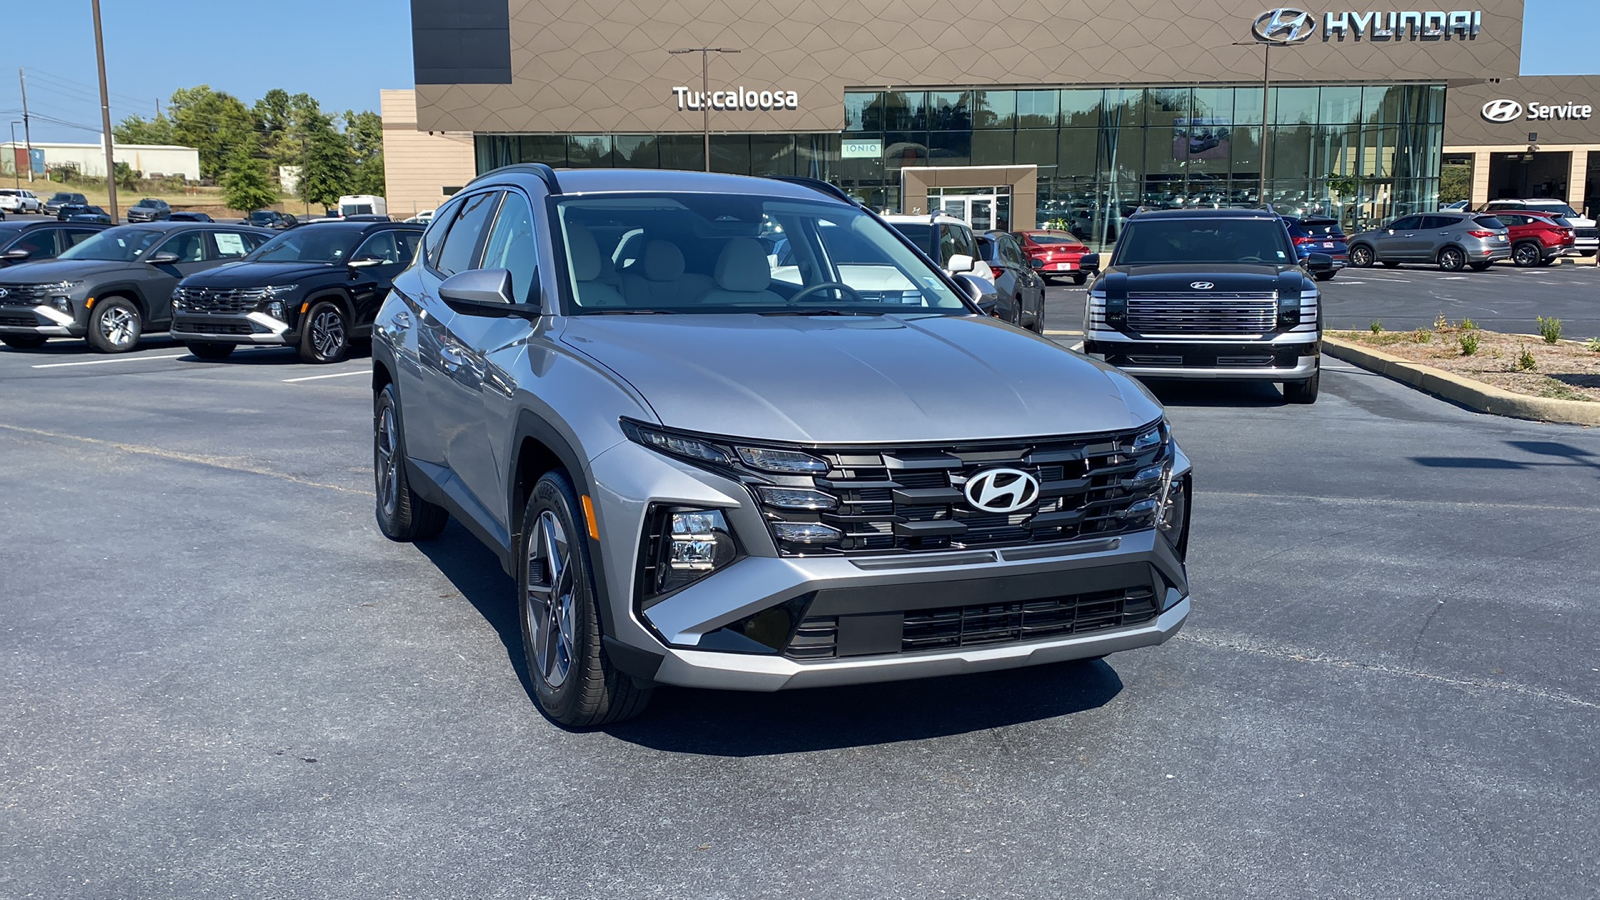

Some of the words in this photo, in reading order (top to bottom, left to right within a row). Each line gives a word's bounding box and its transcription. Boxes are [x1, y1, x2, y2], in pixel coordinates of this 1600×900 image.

[1324, 10, 1482, 39] HYUNDAI
[672, 86, 798, 108] Tuscaloosa
[1527, 101, 1592, 119] Service
